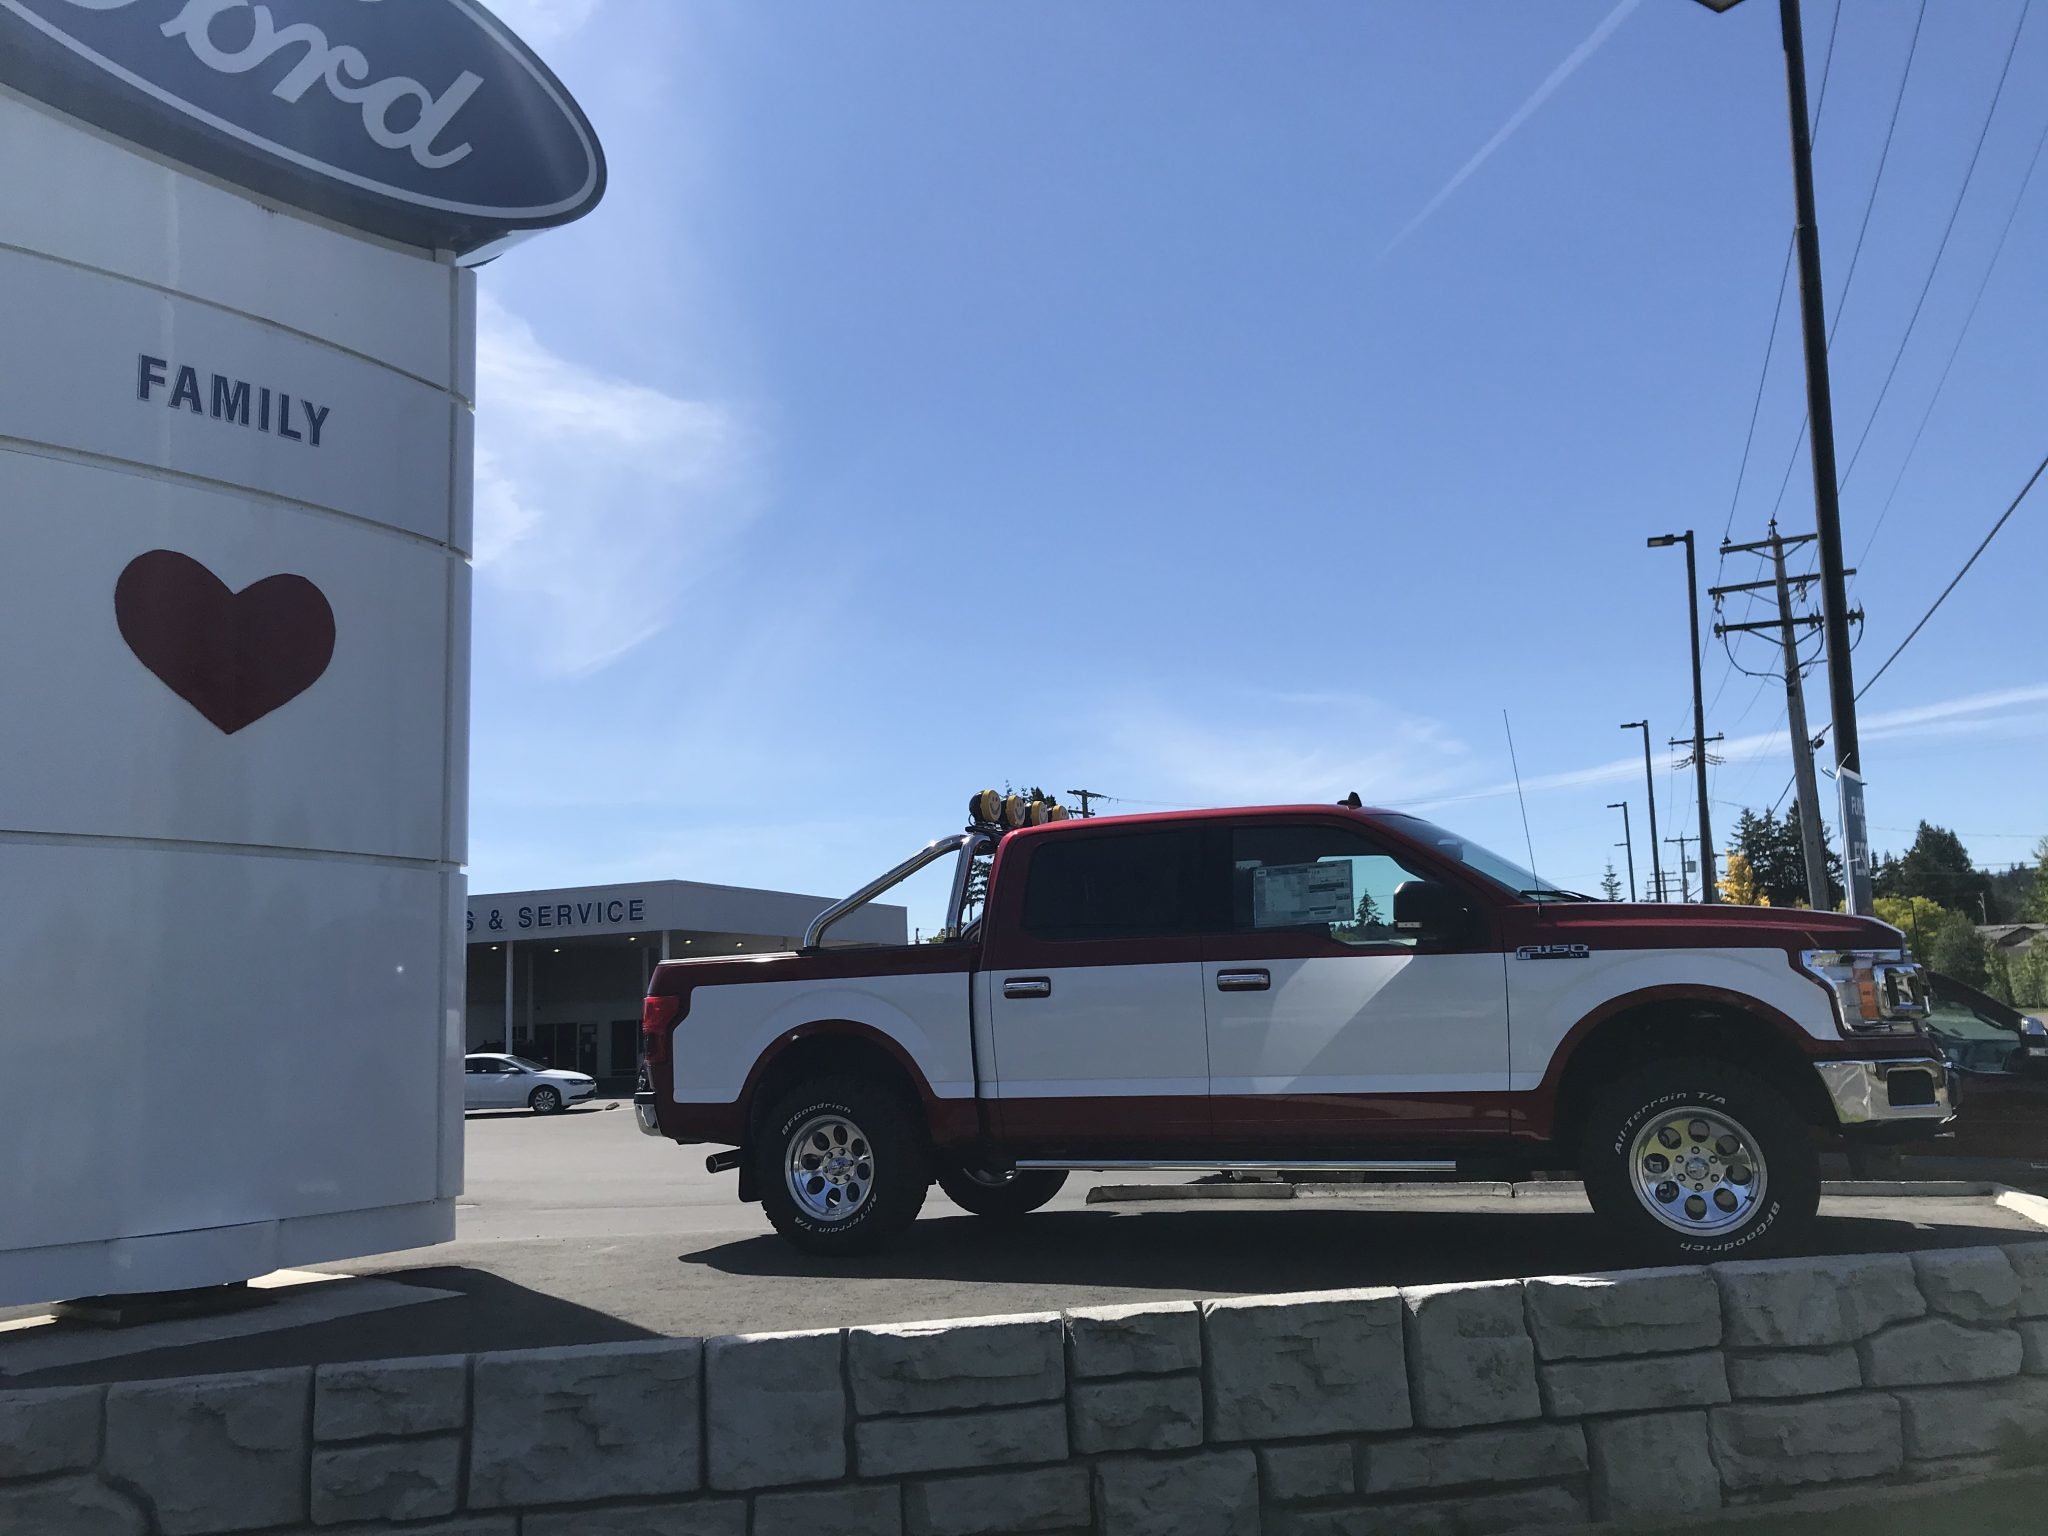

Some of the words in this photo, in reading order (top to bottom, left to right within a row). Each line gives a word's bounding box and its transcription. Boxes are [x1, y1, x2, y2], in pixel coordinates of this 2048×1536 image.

[62, 0, 484, 169] ord
[137, 352, 331, 448] FAMILY
[489, 909, 503, 929] &
[518, 899, 644, 928] SERVICE
[781, 1102, 852, 1136] BFGoodrich
[1614, 1092, 1687, 1155] All-Terrain
[1697, 1091, 1727, 1105] T/A
[1679, 1201, 1781, 1251] BFGoodrich
